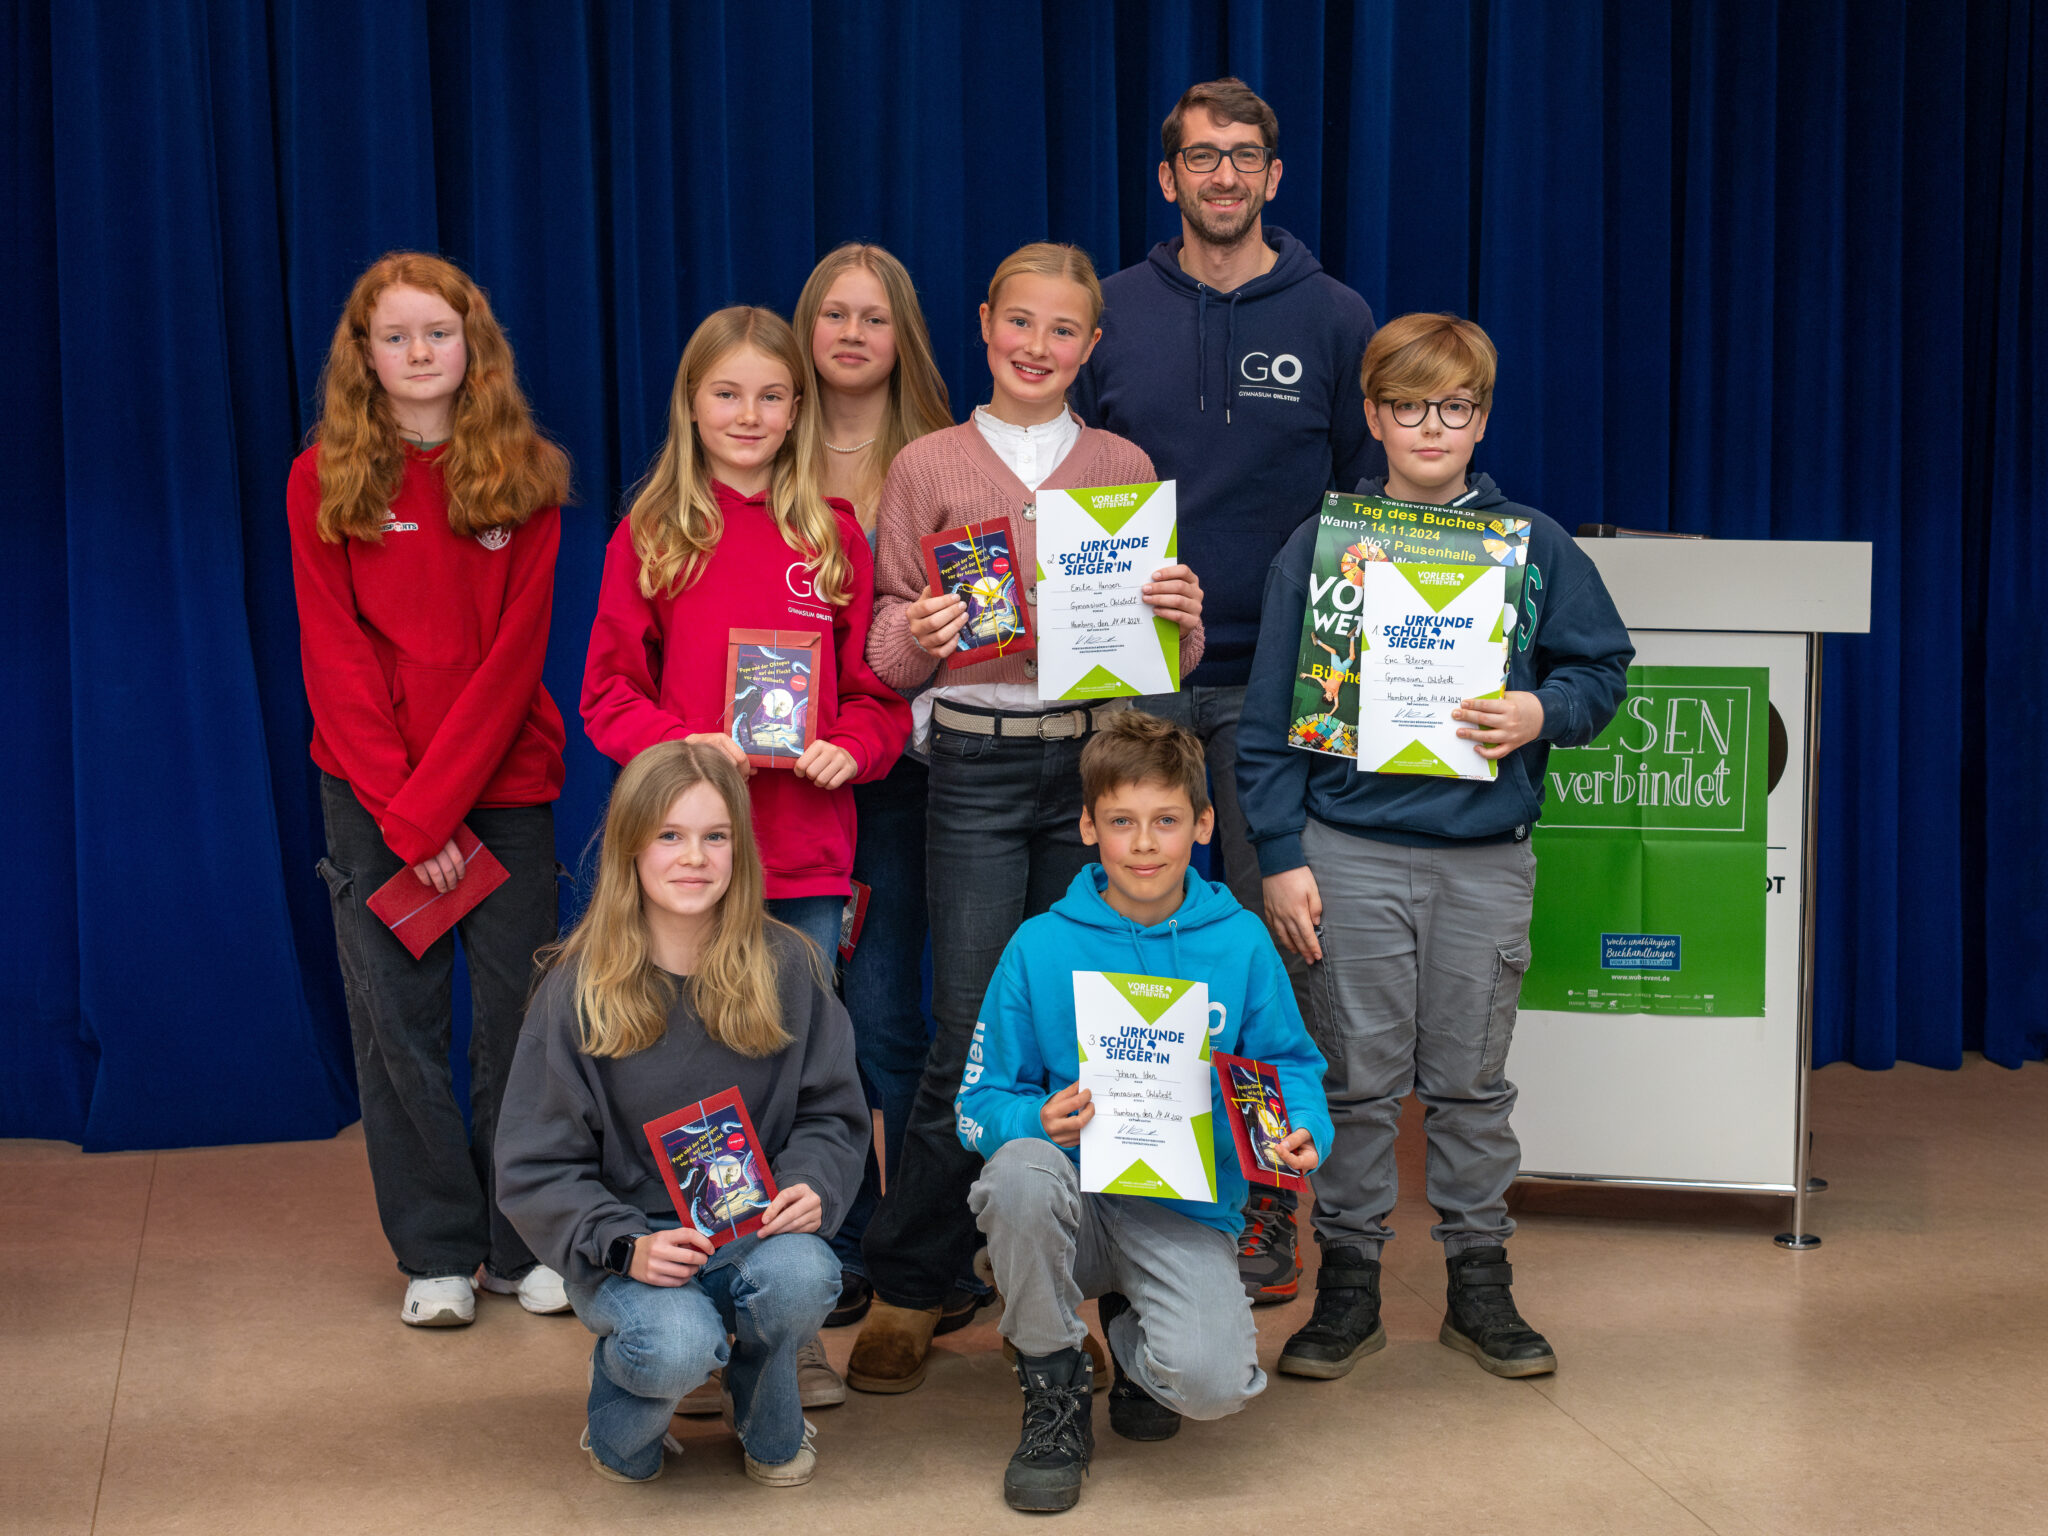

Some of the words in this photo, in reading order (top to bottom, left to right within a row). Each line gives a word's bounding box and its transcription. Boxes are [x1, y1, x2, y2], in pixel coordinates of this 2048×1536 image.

[1241, 352, 1303, 385] GO
[1273, 393, 1300, 402] OHLSTEDT
[1091, 493, 1129, 504] VORLESE
[1093, 500, 1135, 509] WETTBEWERB
[1381, 500, 1476, 517] VORLESEWETTBEWERB.DE
[1353, 502, 1383, 520] Tag
[1388, 508, 1418, 522] des
[1423, 512, 1486, 532] Buches
[1320, 515, 1367, 530] Wann?
[1371, 522, 1441, 541] 14.11.2024
[1080, 536, 1150, 553] URKUNDE
[1360, 535, 1391, 550] Wo?
[1394, 540, 1477, 562] Pausenhalle
[1059, 551, 1105, 565] SCHUL
[1418, 571, 1456, 581] VORLESE
[1405, 614, 1474, 629] URKUNDE
[1383, 625, 1428, 638] SCHUL
[1549, 754, 1732, 808] verbindet
[1606, 947, 1676, 961] Buchhandlungen
[1127, 981, 1165, 992] VORLESE
[1130, 990, 1170, 999] WETTBEWERB
[1120, 1025, 1185, 1044] URKUNDE
[1100, 1036, 1145, 1050] SCHUL
